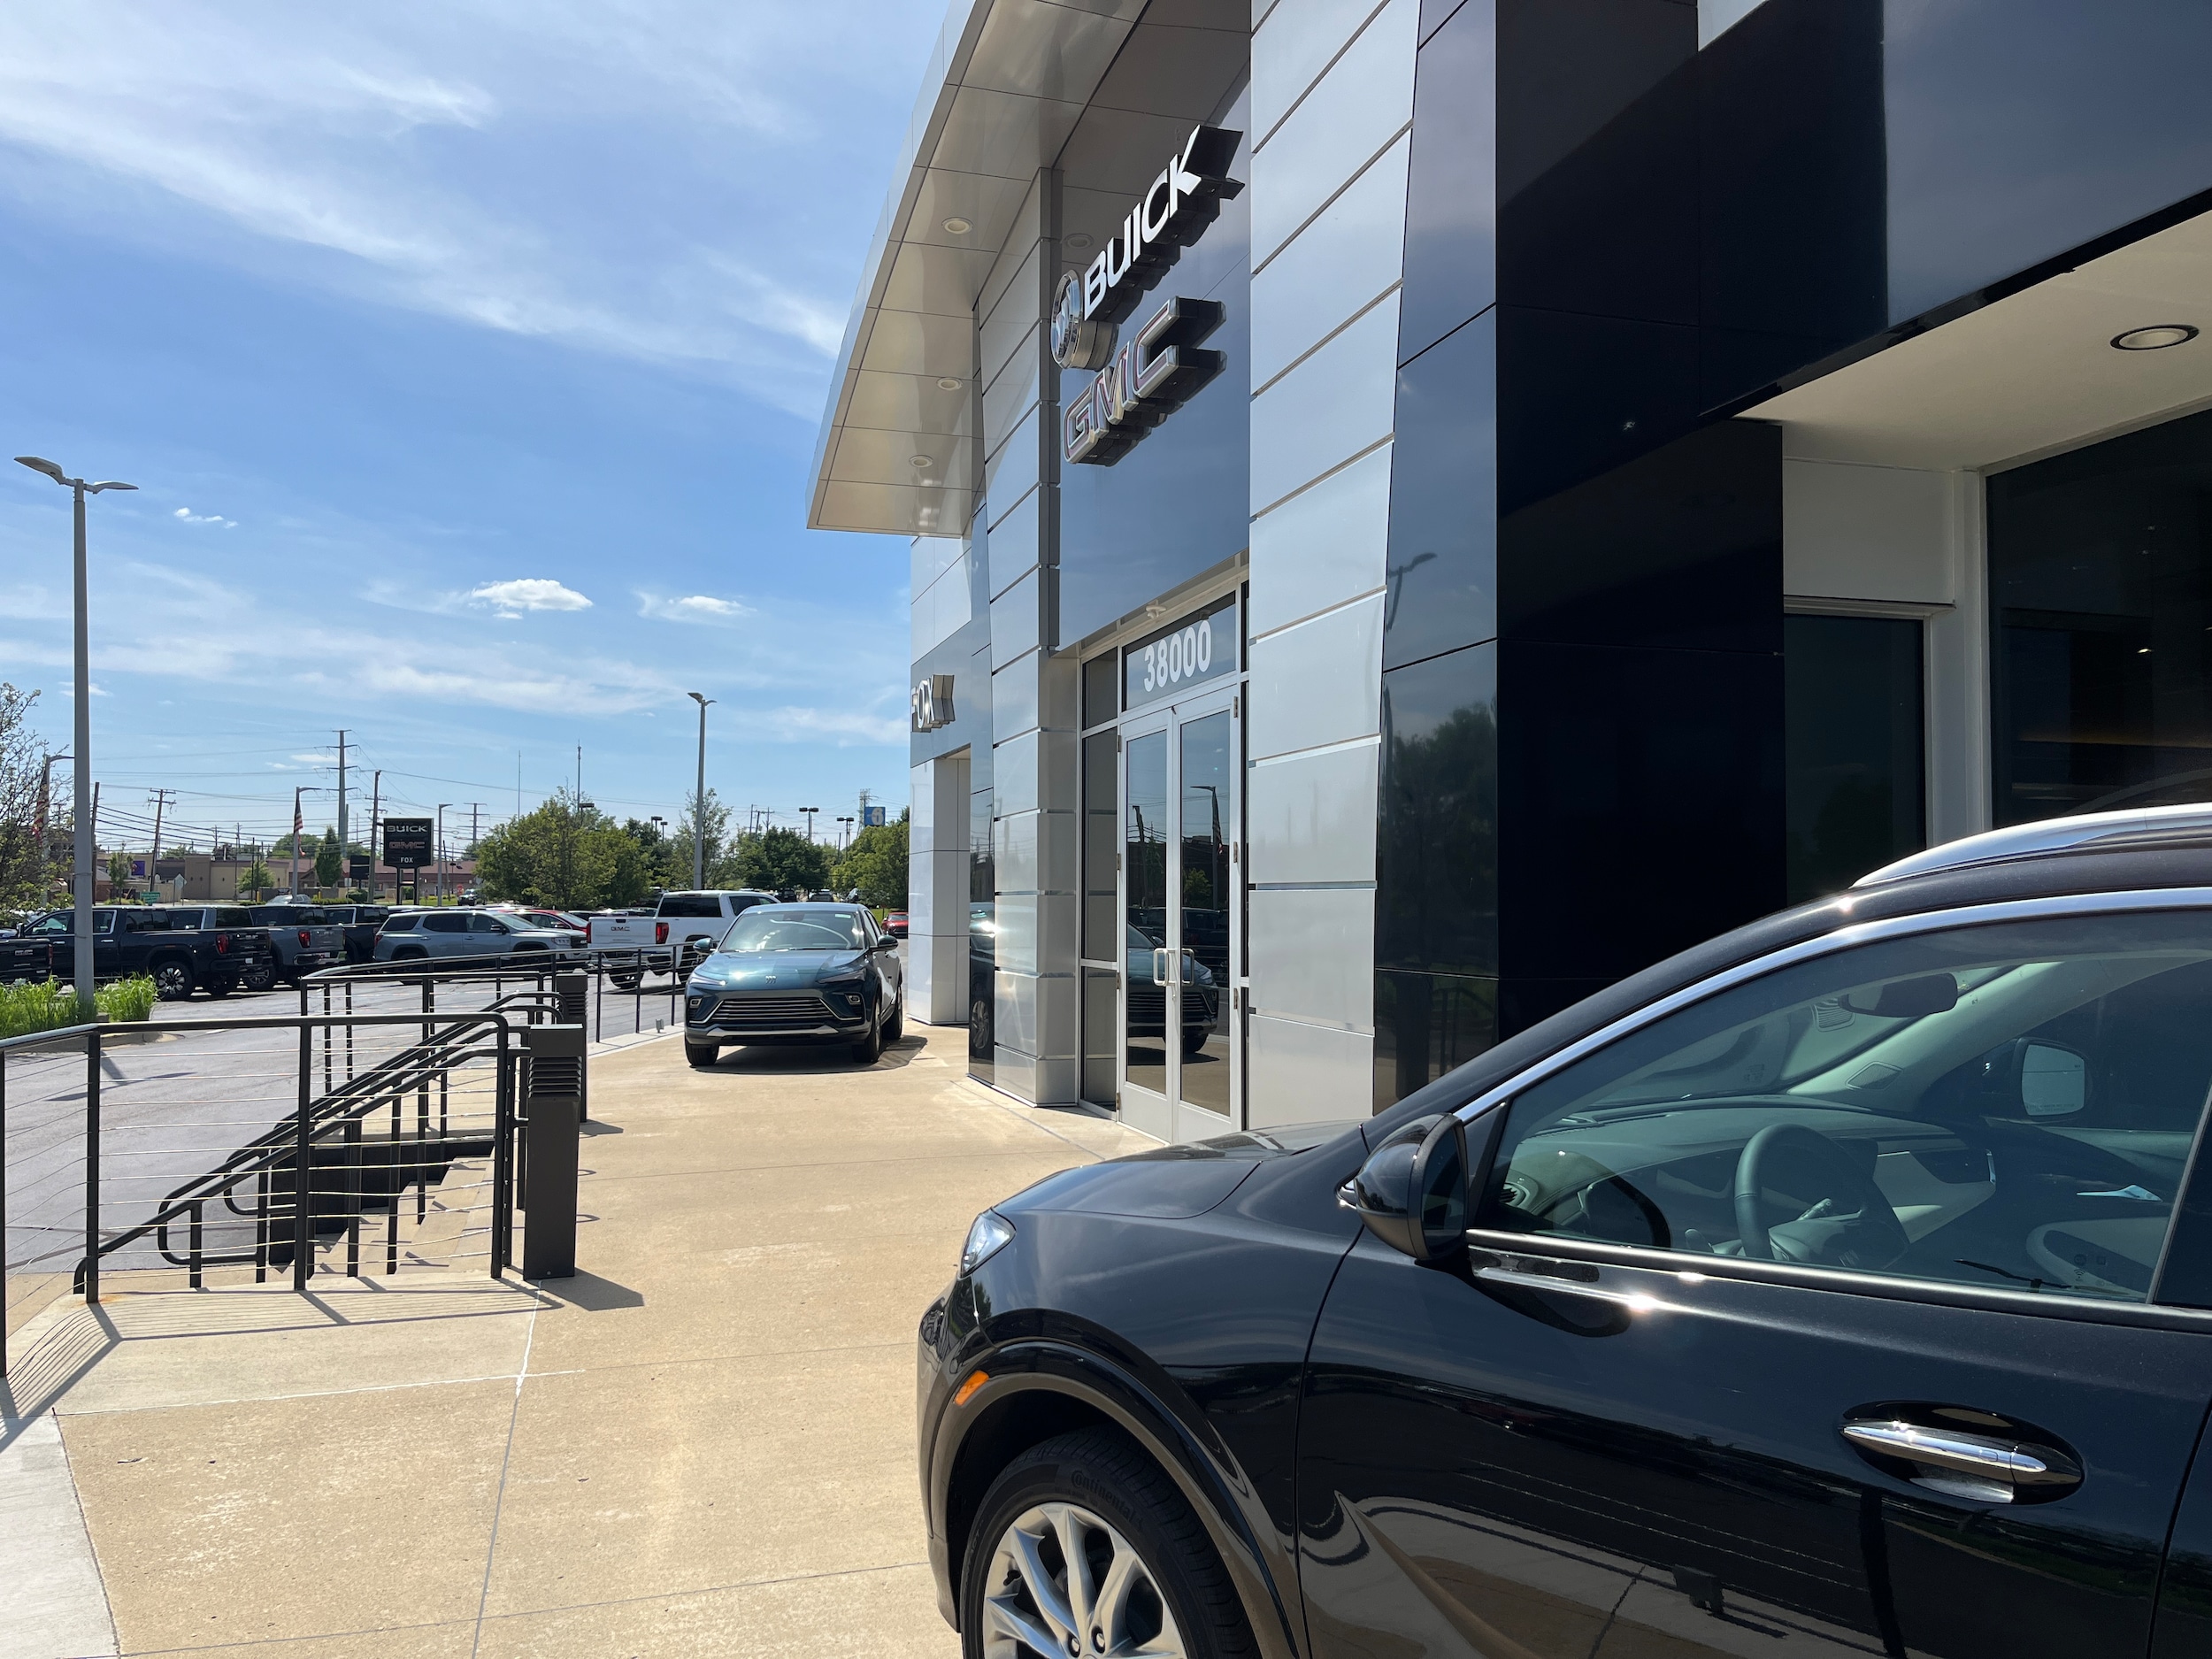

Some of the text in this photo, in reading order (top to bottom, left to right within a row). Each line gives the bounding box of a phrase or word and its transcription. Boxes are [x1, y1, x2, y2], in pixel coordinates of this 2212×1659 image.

[1083, 124, 1202, 321] BUICK
[1064, 295, 1181, 465] GMC
[1144, 620, 1211, 692] 38000
[1071, 1470, 1135, 1522] Continental
